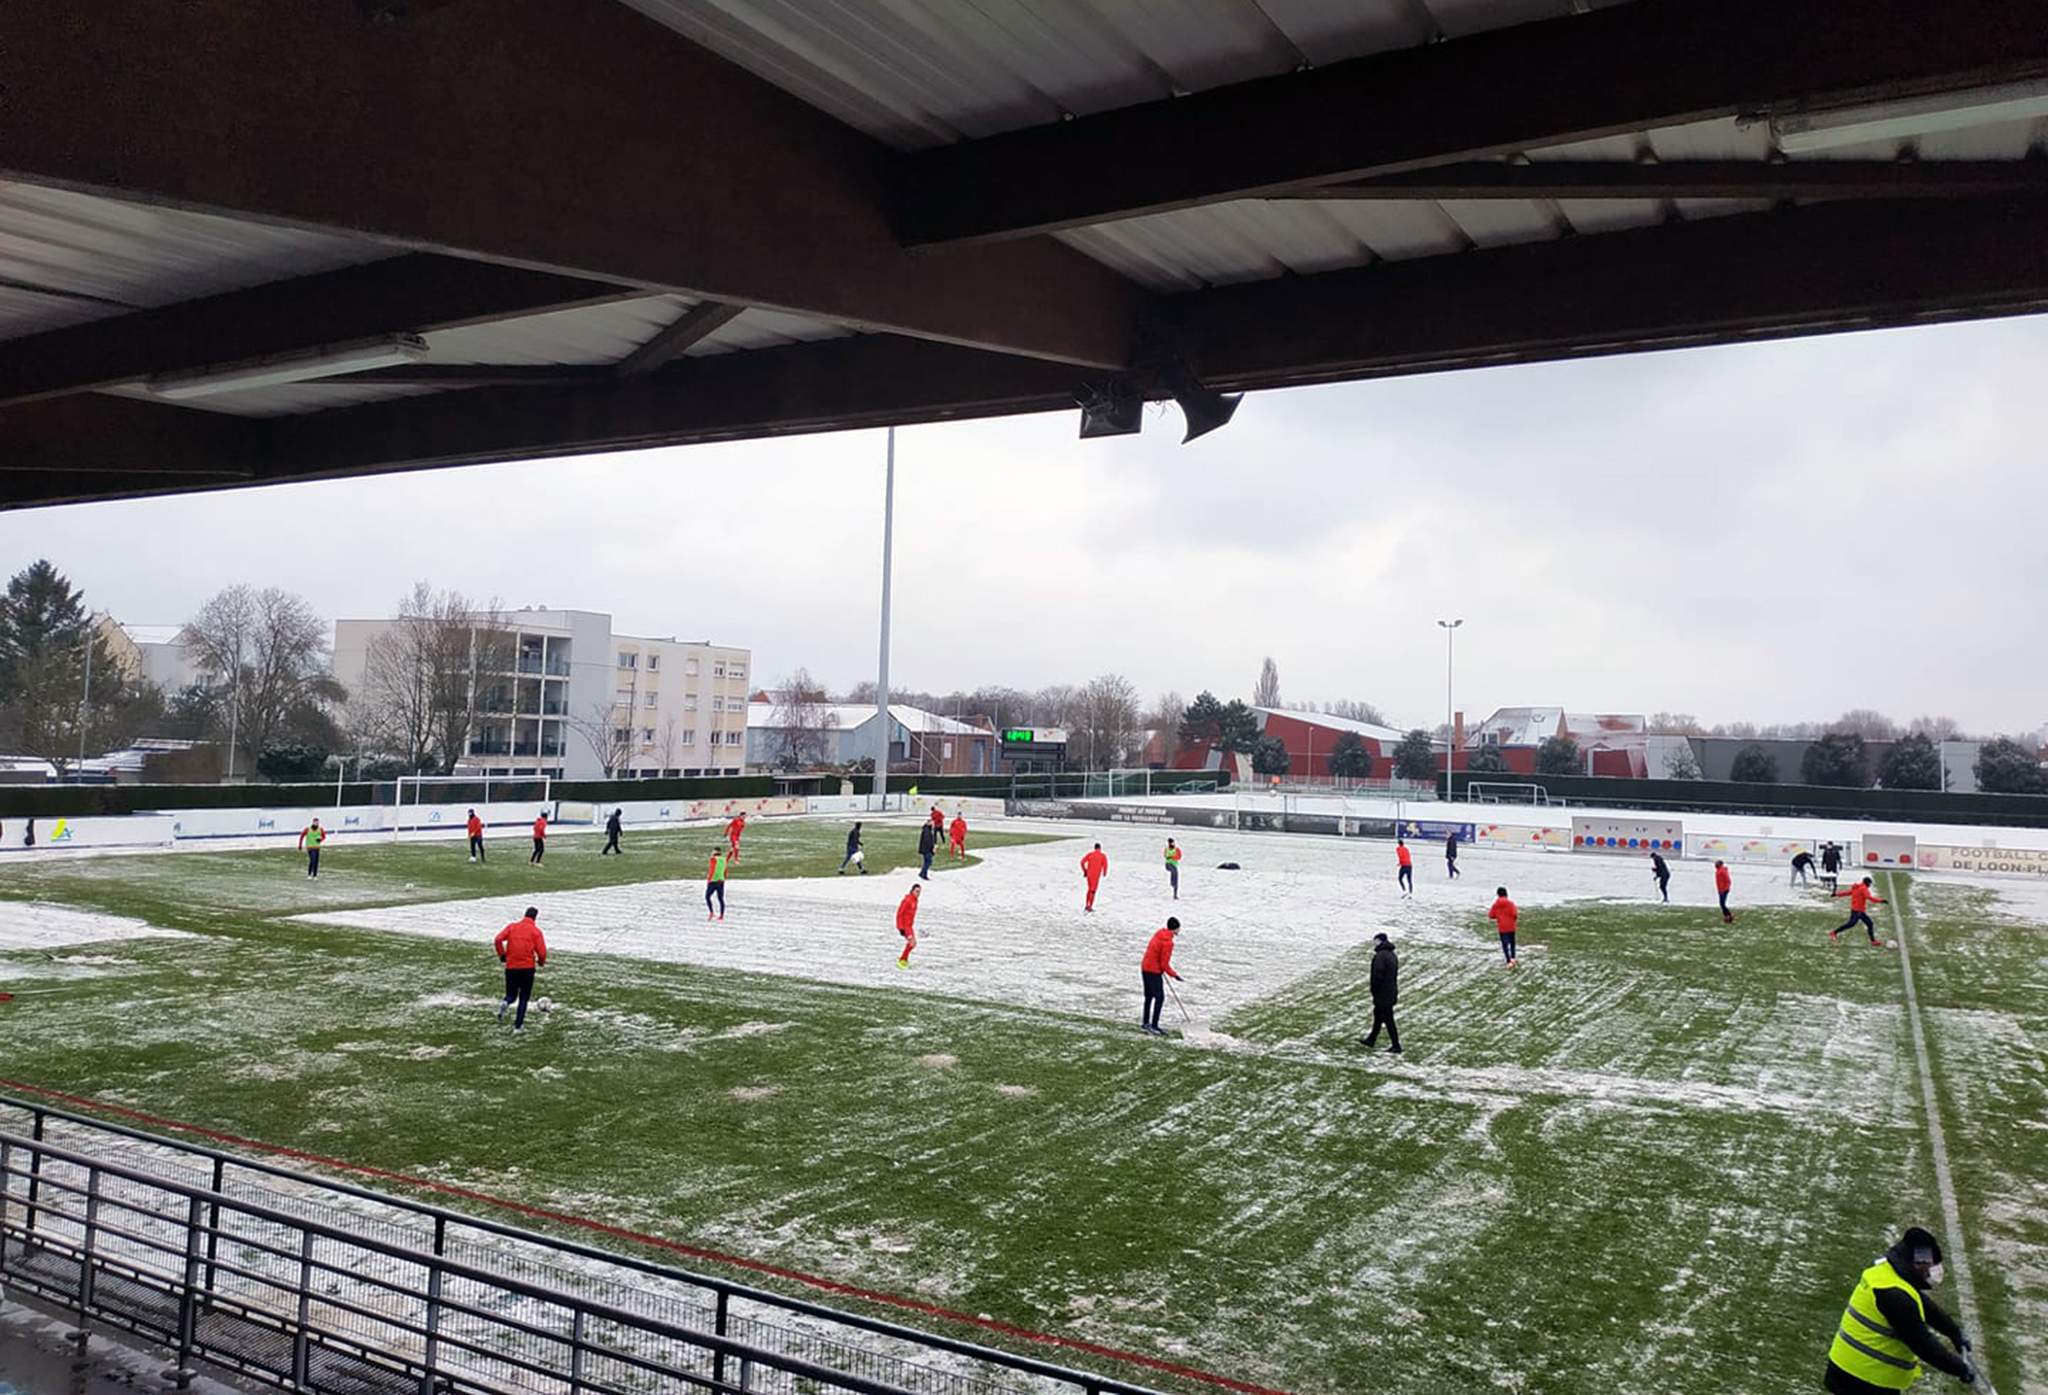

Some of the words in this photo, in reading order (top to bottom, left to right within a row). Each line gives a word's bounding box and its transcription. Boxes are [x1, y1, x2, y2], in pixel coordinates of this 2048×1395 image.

[1950, 847, 2033, 861] FOOTBALL
[1952, 860, 1973, 870] DE
[1978, 862, 2048, 874] LOON-PL
